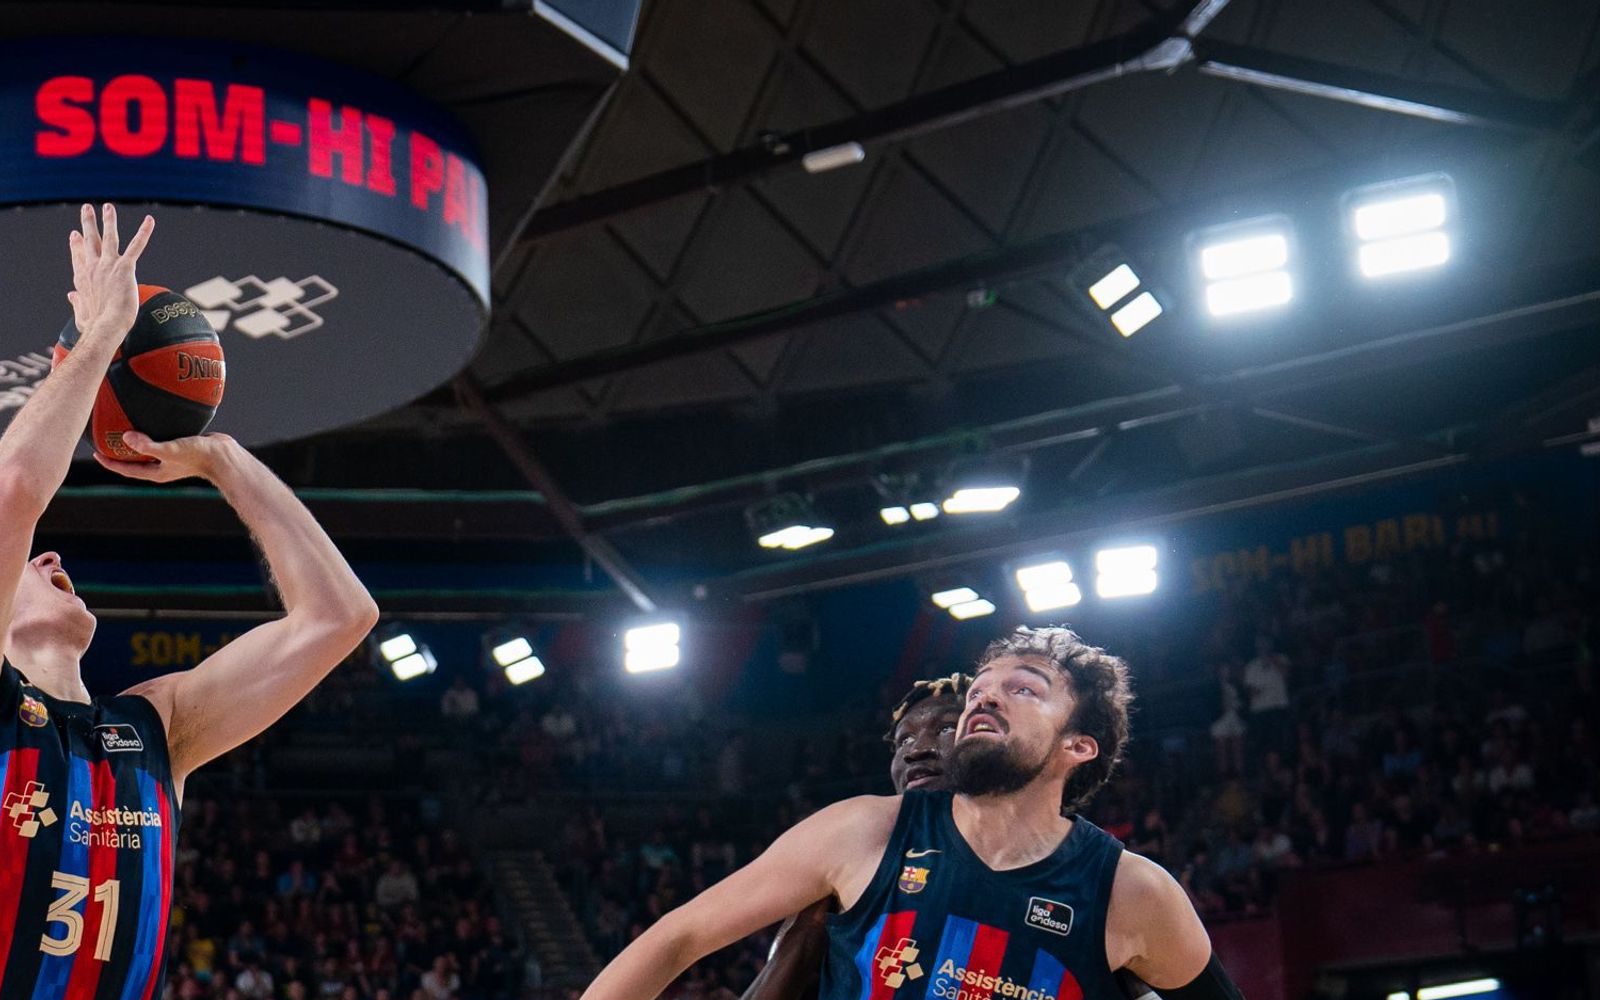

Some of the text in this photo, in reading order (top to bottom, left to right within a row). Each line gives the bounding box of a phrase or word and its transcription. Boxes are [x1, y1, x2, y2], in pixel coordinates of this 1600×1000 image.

[34, 73, 397, 197] SOM-HI
[69, 800, 162, 828] Assistència
[69, 822, 142, 850] Sanitària
[38, 870, 121, 963] 31
[1030, 914, 1068, 931] endesa
